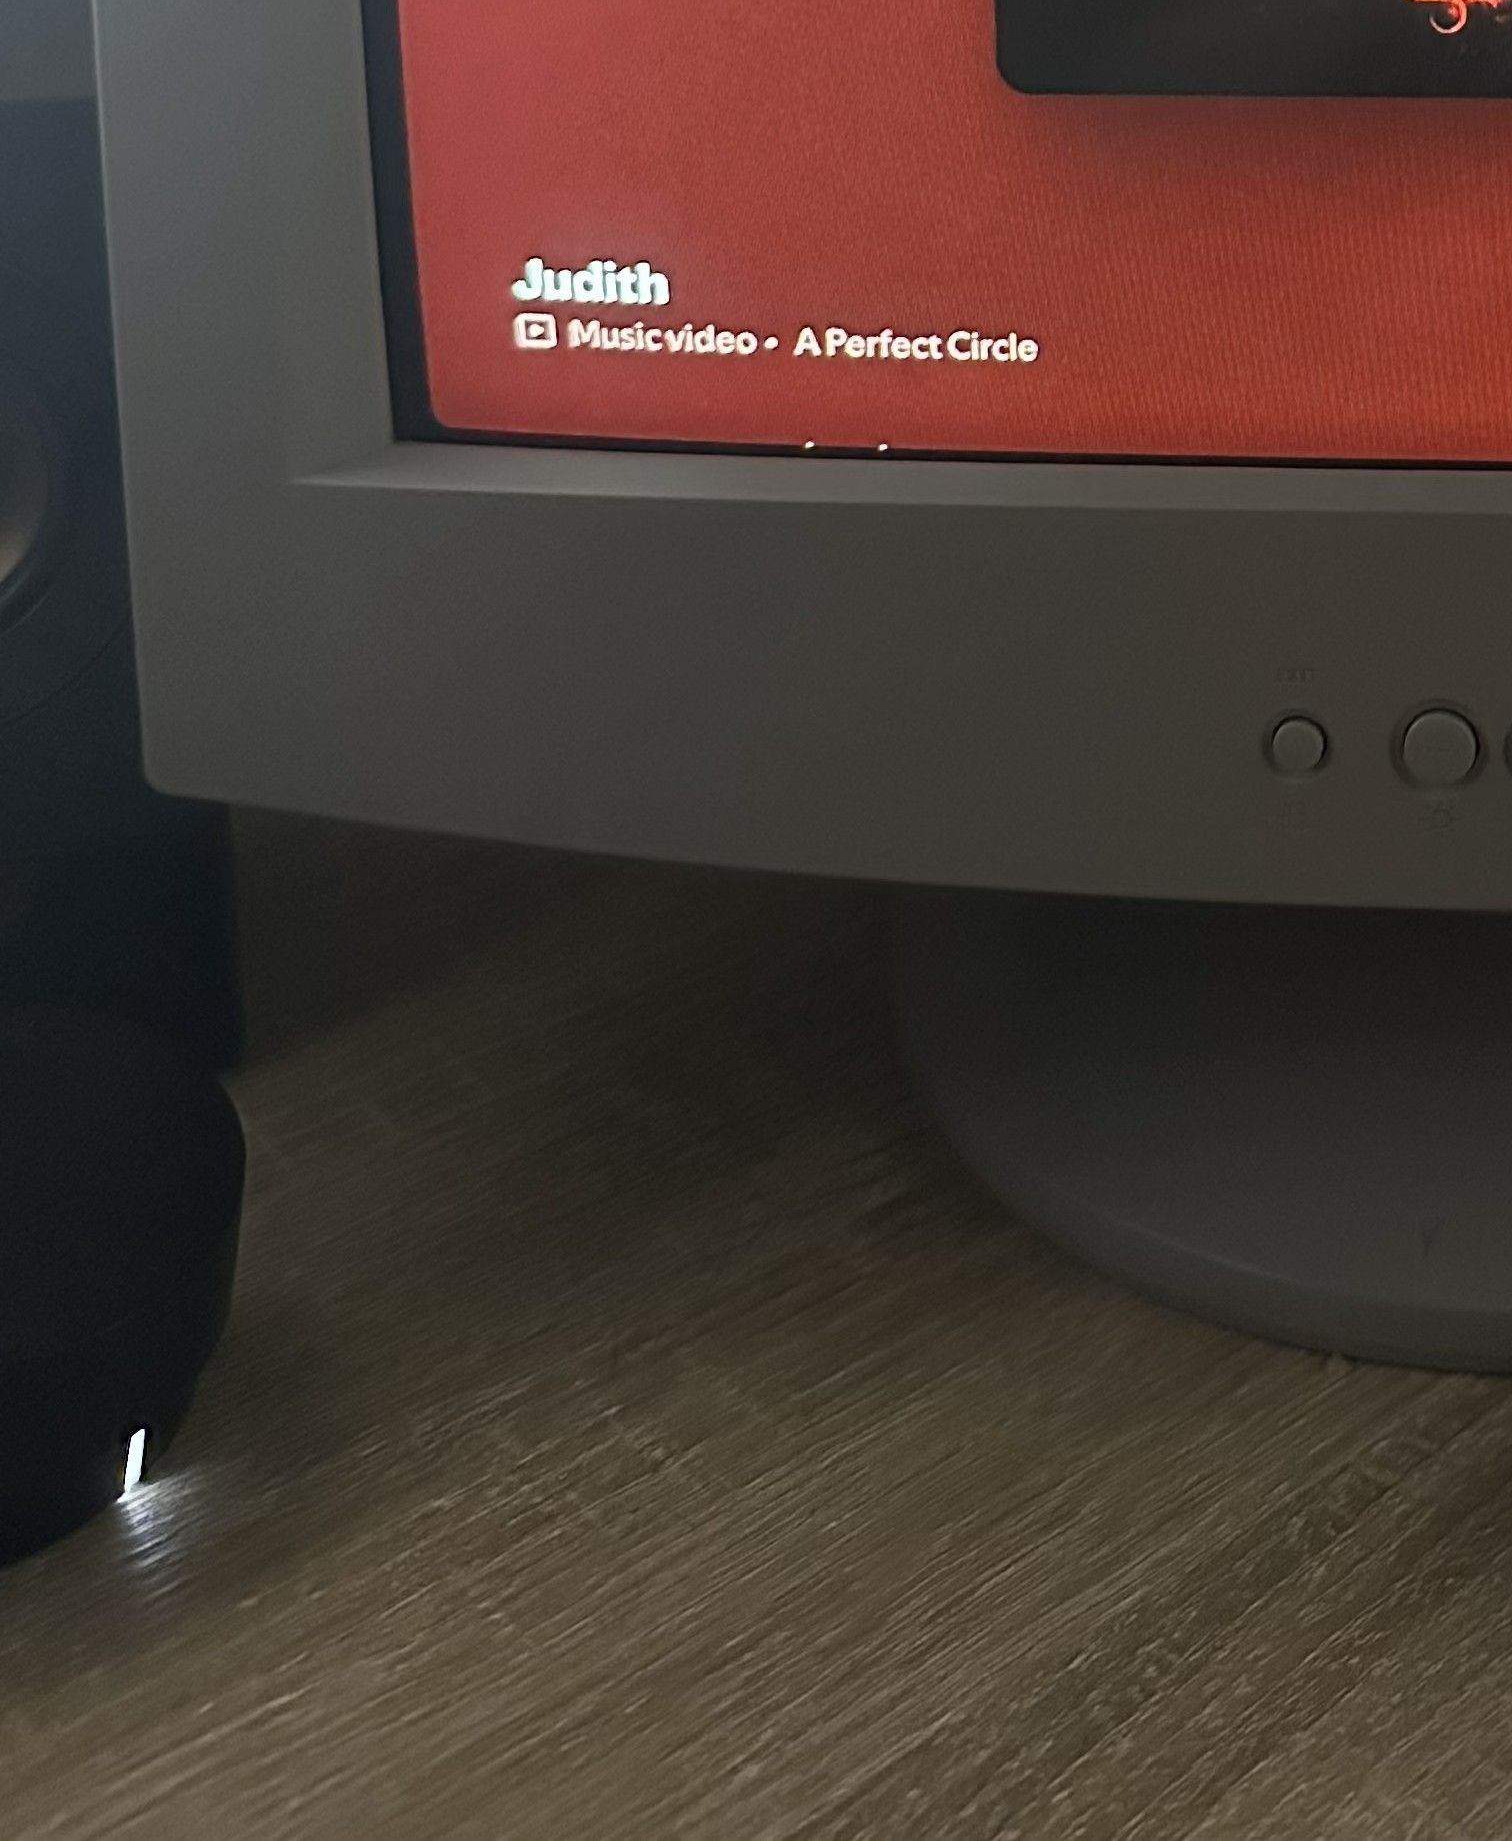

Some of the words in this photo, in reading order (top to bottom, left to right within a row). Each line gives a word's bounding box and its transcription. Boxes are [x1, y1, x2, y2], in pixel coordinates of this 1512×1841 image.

[512, 257, 671, 306] Judith
[568, 318, 663, 353] Music
[664, 326, 759, 355] video
[793, 327, 822, 356] A
[826, 328, 942, 360] Perfect
[947, 331, 1039, 362] Circle
